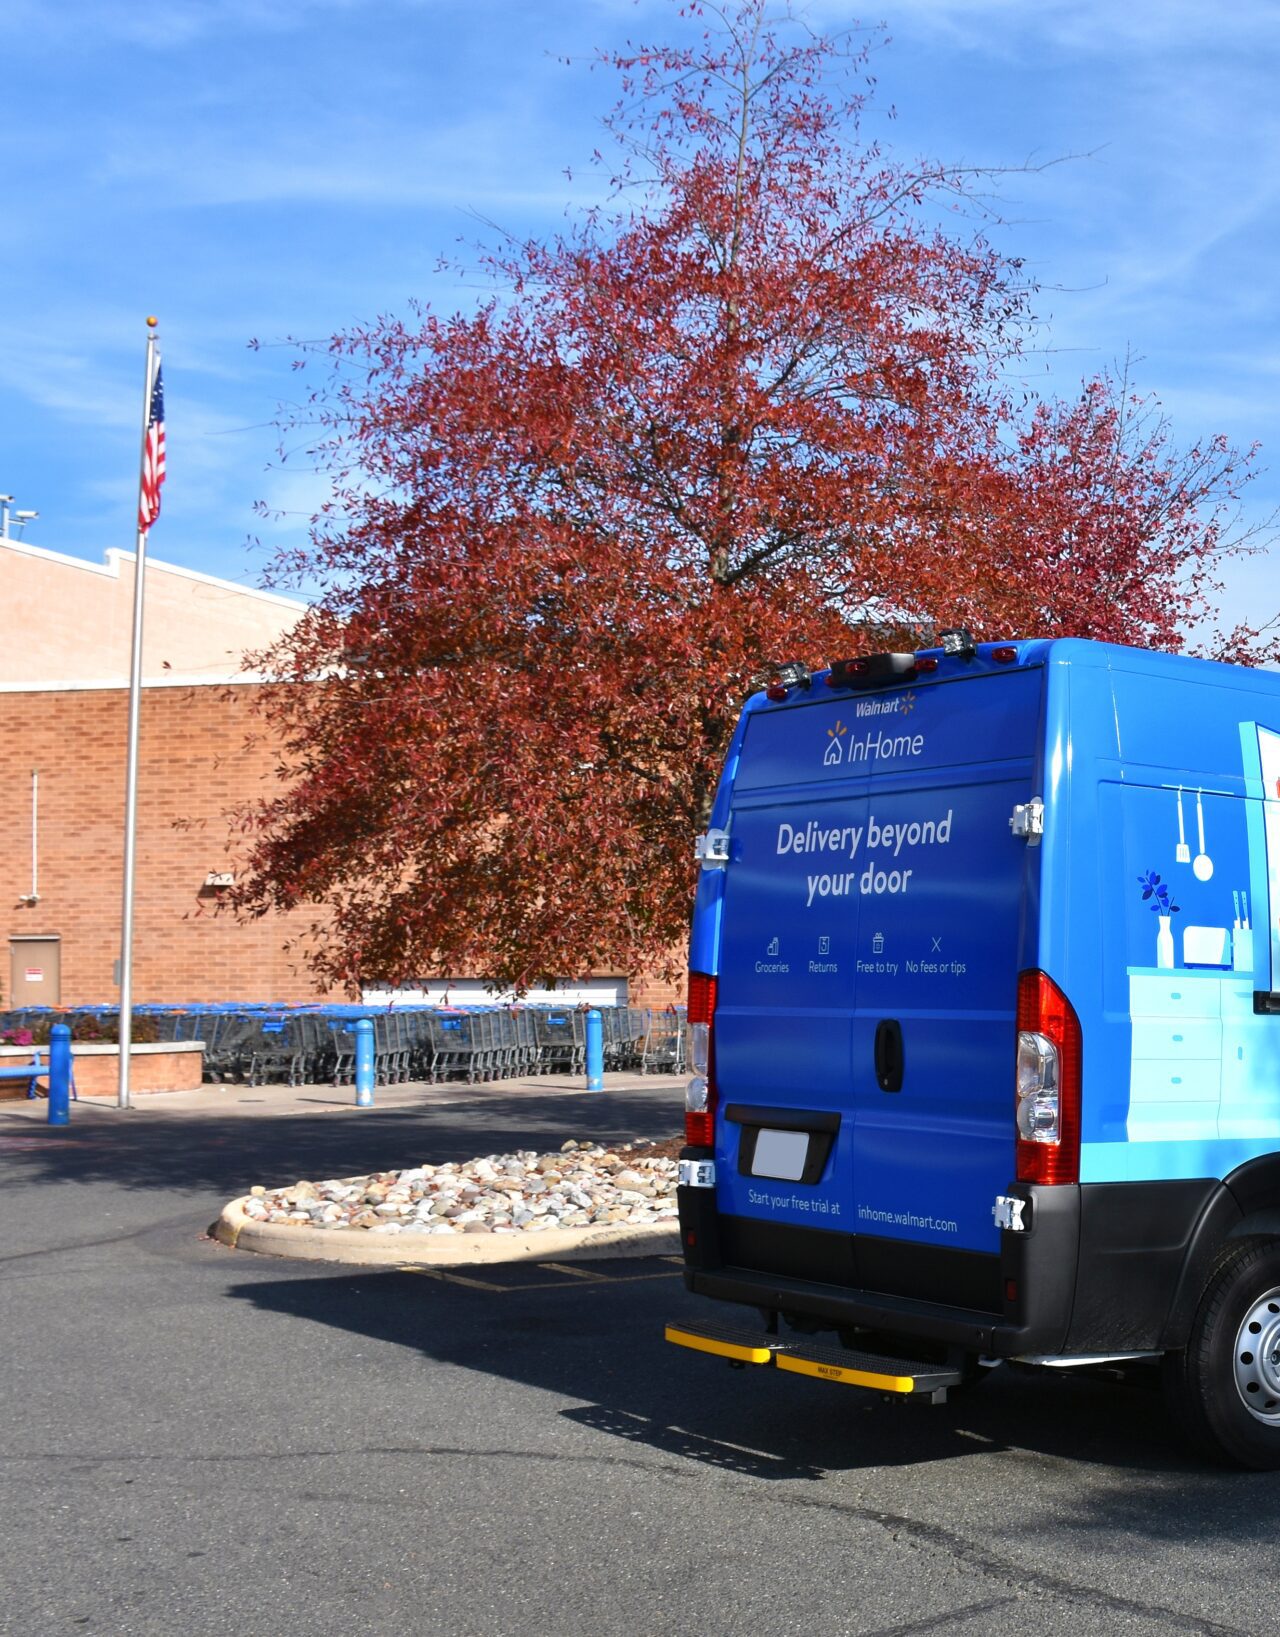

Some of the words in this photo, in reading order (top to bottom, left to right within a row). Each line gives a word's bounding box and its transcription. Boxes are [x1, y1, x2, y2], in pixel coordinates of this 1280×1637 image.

[856, 697, 900, 718] Walmart
[848, 732, 924, 763] InHome
[776, 821, 863, 859] Delivery
[866, 809, 953, 857] beyond
[807, 872, 855, 907] your
[860, 862, 912, 895] door
[755, 960, 790, 973] Groceries
[808, 960, 838, 973] Returns
[856, 960, 875, 973] Free
[875, 962, 885, 973] to
[886, 962, 899, 976] try
[905, 960, 919, 973] No
[920, 960, 938, 973] fees
[939, 963, 949, 973] or
[950, 960, 966, 976] tips
[748, 1189, 769, 1205] Start
[770, 1194, 790, 1210] your
[791, 1195, 810, 1211] free
[811, 1199, 829, 1214] trial
[830, 1202, 841, 1215] at
[858, 1205, 957, 1232] inhome.walmart.com
